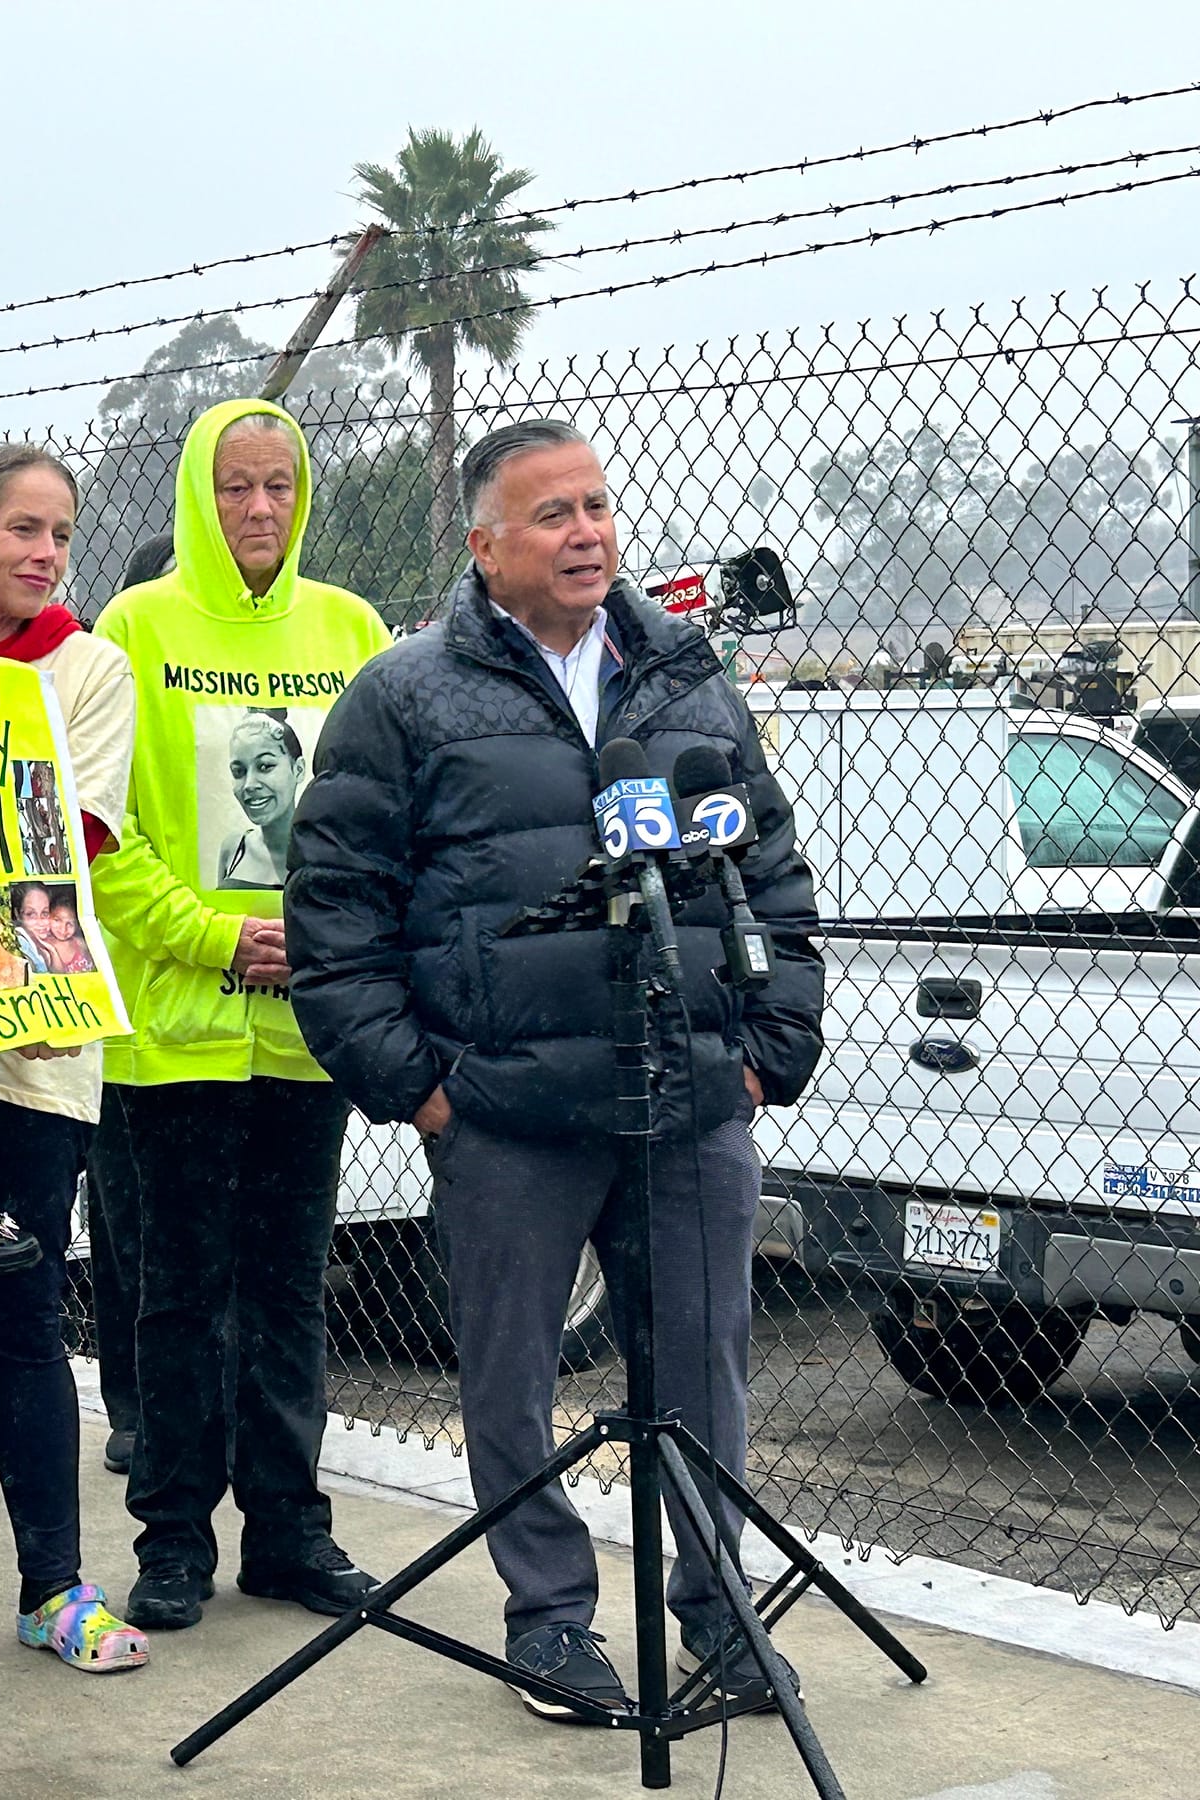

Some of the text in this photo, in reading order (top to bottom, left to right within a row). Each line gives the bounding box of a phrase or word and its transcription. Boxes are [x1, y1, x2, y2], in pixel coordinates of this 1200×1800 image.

[164, 662, 347, 698] MISSING PERSON
[593, 787, 620, 812] KTLA
[622, 780, 666, 794] KTLA
[603, 804, 628, 859] 5
[634, 798, 672, 847] 5
[681, 793, 747, 846] abc 7
